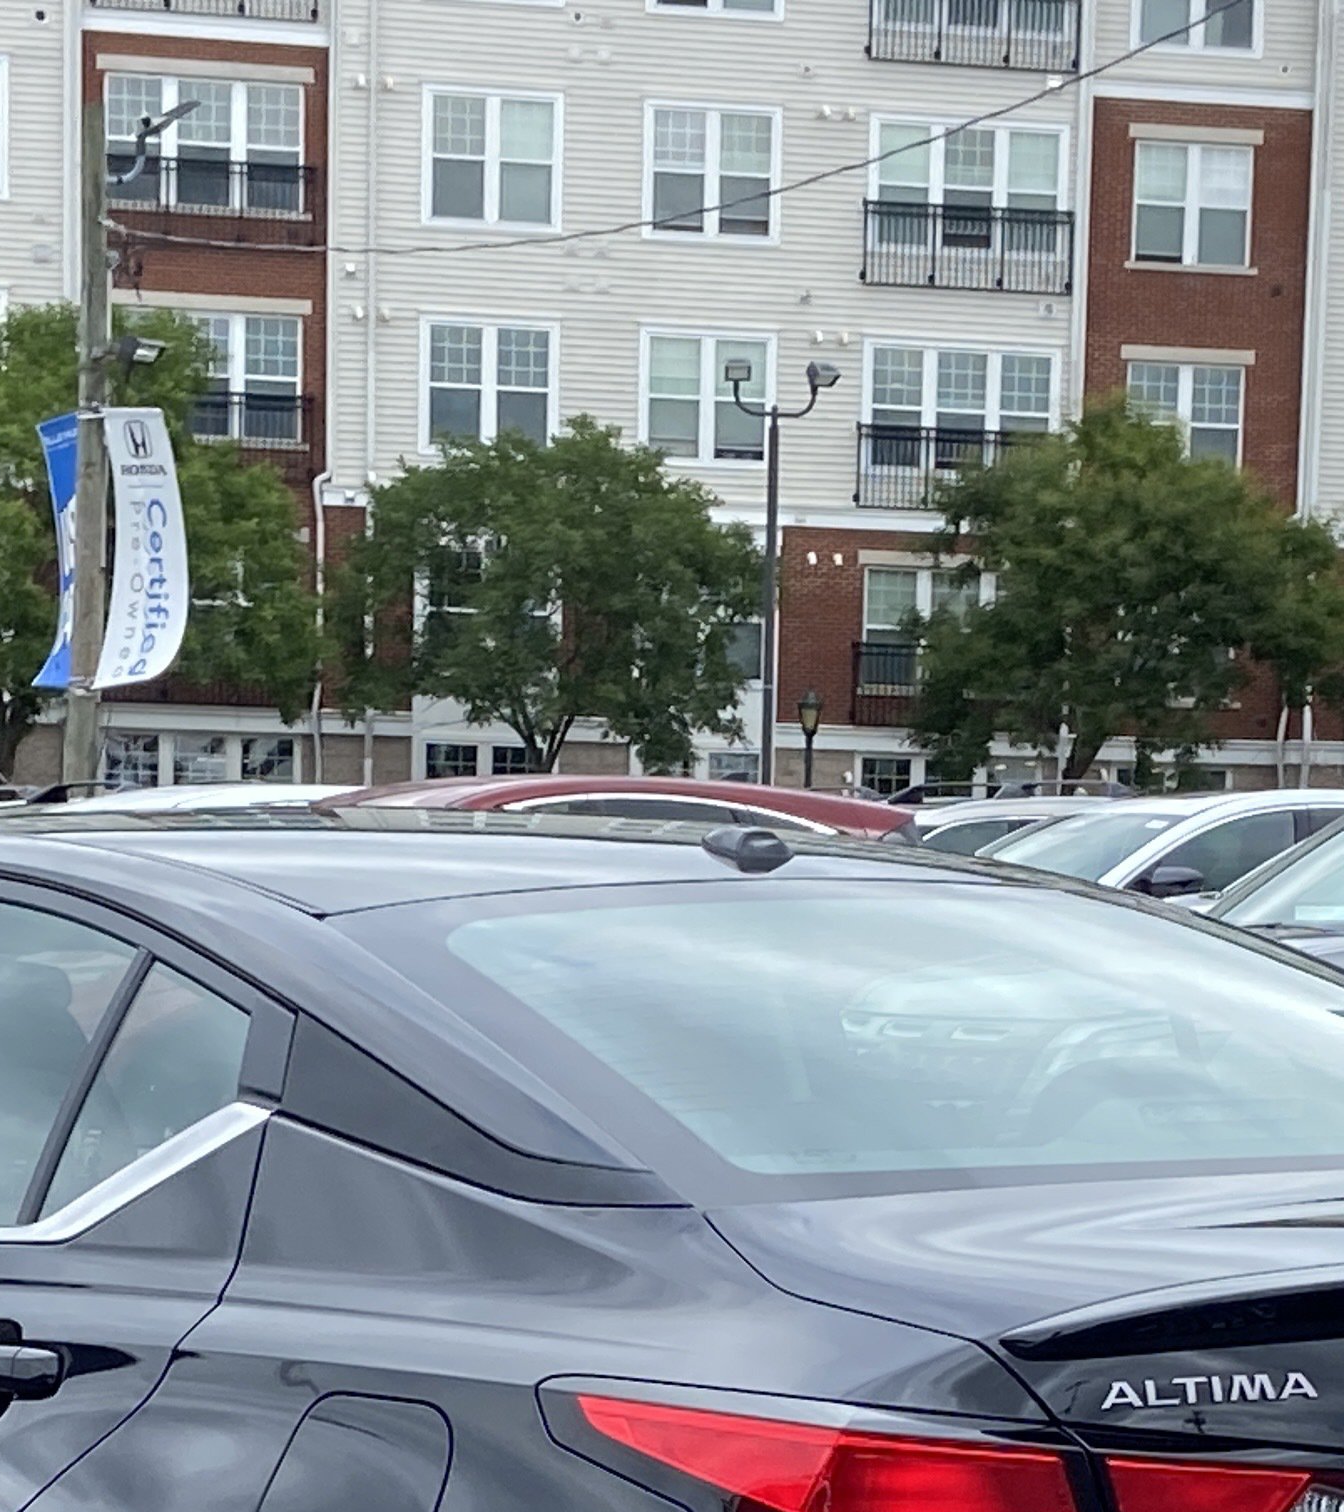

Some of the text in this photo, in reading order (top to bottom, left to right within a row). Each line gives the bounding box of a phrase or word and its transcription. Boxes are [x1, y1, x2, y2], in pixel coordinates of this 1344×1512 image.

[120, 464, 168, 476] HONDA
[128, 498, 170, 676] Certified
[1101, 1372, 1318, 1411] ALTIMA
